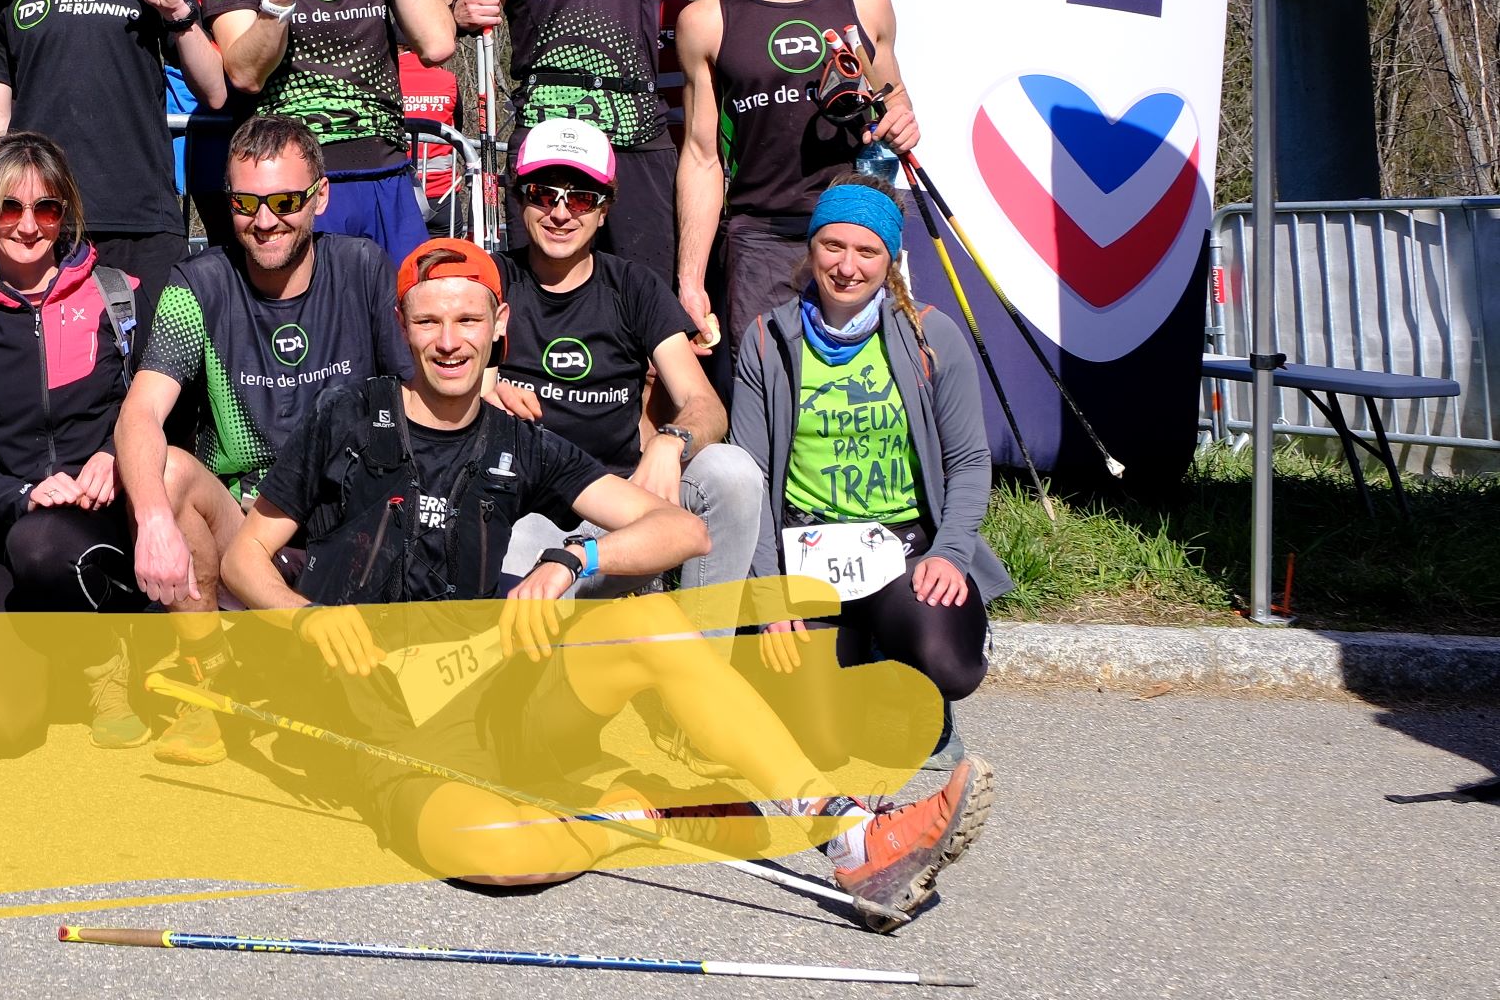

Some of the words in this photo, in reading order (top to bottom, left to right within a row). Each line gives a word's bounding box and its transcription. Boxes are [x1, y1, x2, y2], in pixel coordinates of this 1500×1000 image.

[18, 0, 46, 20] TDR
[58, 3, 74, 13] DE
[311, 8, 331, 23] de
[334, 2, 387, 21] running
[774, 35, 821, 55] TDR
[402, 95, 451, 104] COURISTE
[774, 85, 800, 104] de
[402, 103, 428, 112] DPS
[430, 103, 444, 112] 73
[275, 335, 305, 353] TDR
[548, 352, 587, 368] TDR
[240, 371, 274, 388] terre
[277, 373, 296, 388] de
[298, 360, 352, 385] running
[540, 382, 563, 400] de
[568, 387, 629, 404] running
[815, 402, 905, 438] J'PEUX
[833, 434, 870, 462] PAS
[820, 456, 914, 511] TRAIL
[419, 494, 448, 512] ERR
[827, 556, 866, 584] 541
[435, 643, 480, 687] 573
[278, 716, 326, 739] LEKI
